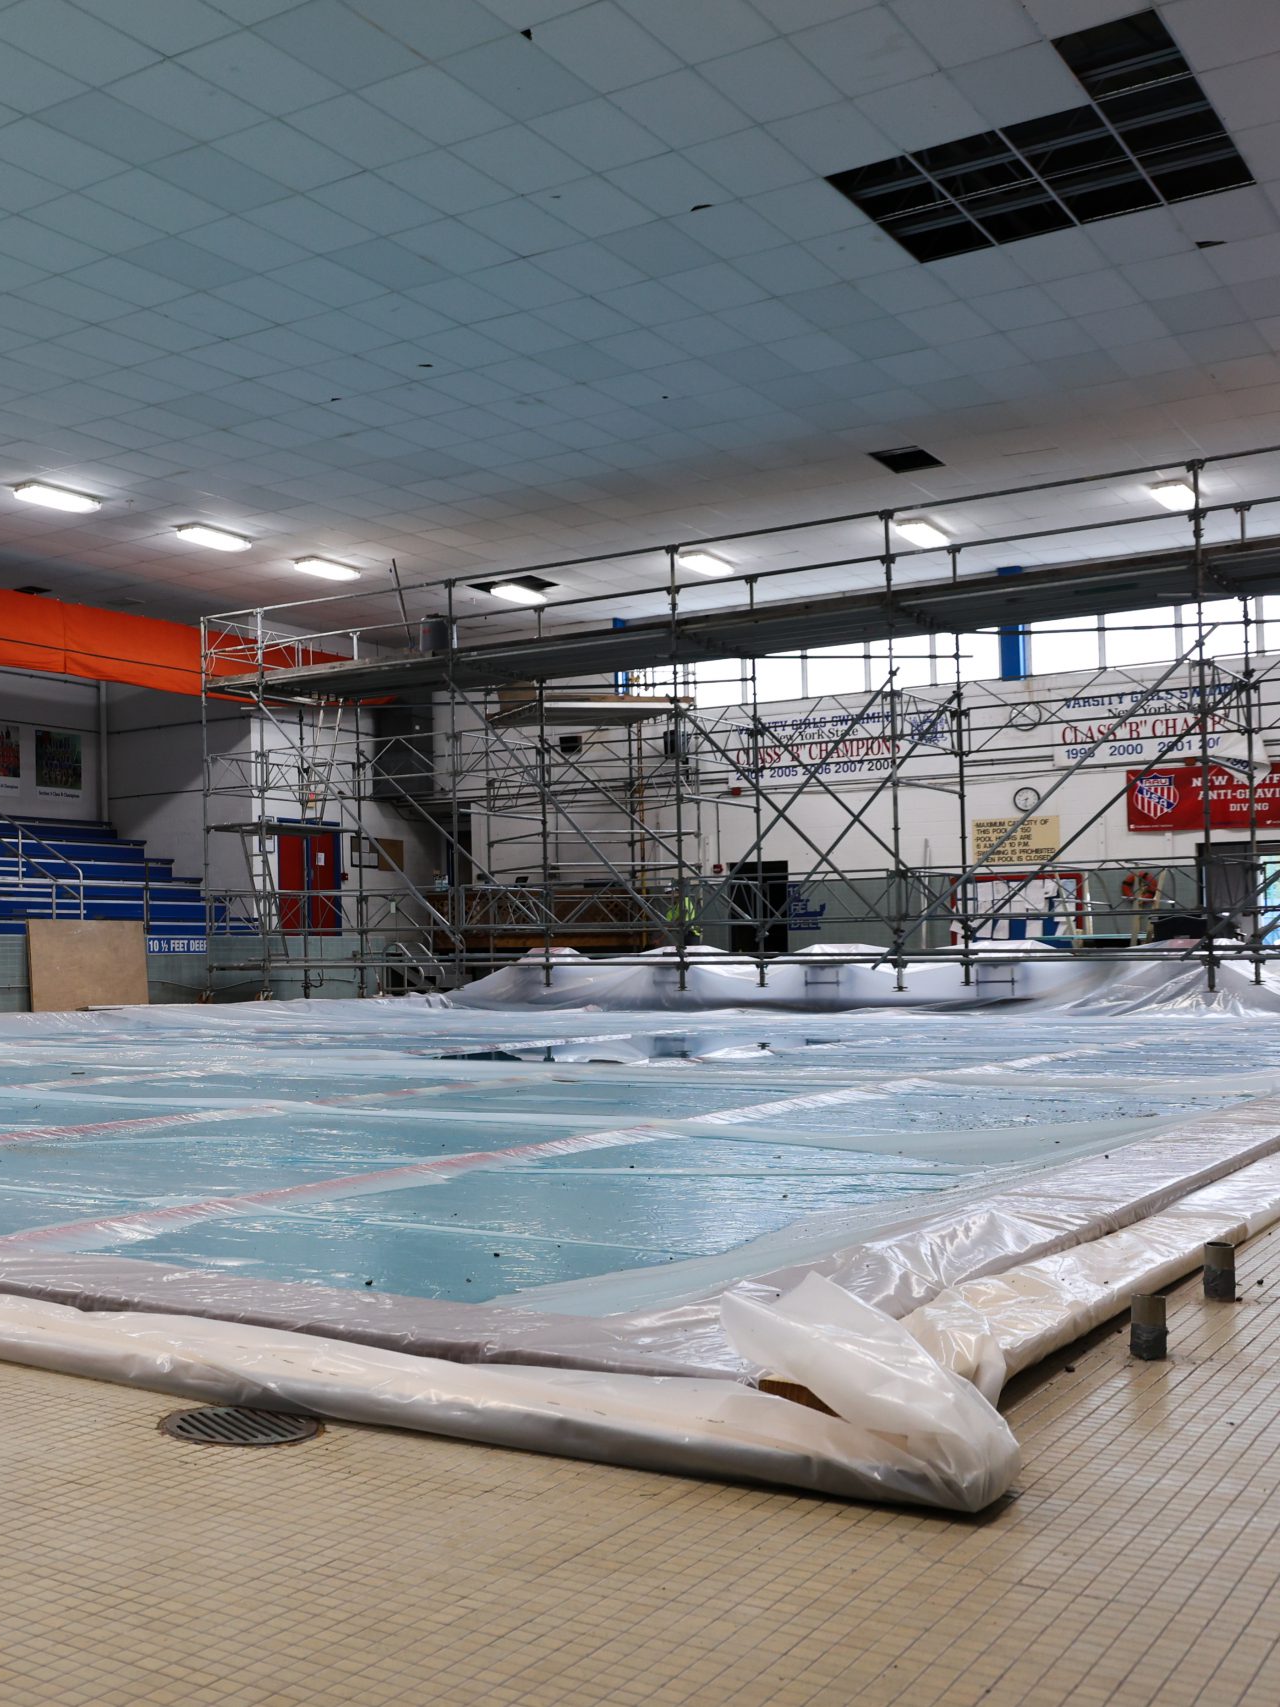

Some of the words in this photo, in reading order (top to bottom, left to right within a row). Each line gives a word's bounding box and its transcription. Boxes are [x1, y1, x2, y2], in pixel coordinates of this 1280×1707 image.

[799, 729, 824, 741] York
[1062, 723, 1117, 744] CLASS
[1109, 743, 1143, 756] 2000
[770, 767, 798, 778] 2005
[834, 762, 864, 773] 2007
[1143, 788, 1168, 808] USA
[1230, 802, 1269, 811] DIVNG
[149, 940, 159, 952] 10
[160, 940, 168, 952] ½
[170, 940, 188, 952] FEET
